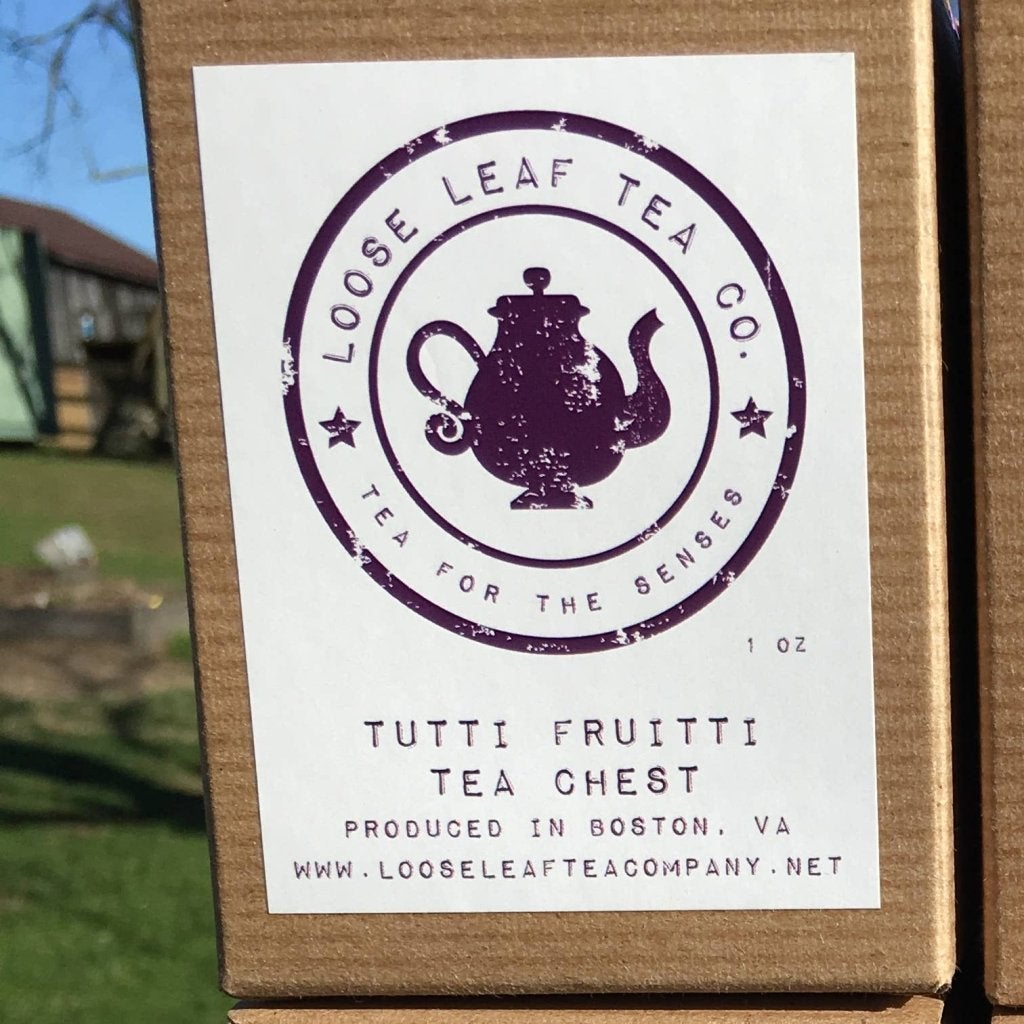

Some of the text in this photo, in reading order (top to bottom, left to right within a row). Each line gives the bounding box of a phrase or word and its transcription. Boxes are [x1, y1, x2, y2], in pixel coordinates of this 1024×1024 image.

[321, 156, 760, 364] LOOSE LEAF TEA CO.
[361, 483, 743, 615] TEA FOR THE SENSES
[746, 636, 806, 654] 1 OZ
[363, 716, 757, 749] TUTTI FRUITTI
[429, 765, 699, 798] TEA CHEST
[345, 818, 502, 839] PRODUCED
[530, 818, 564, 838] IN
[754, 815, 790, 835] VA
[293, 855, 842, 880] WWW.LOOSELEAFTEACOMPANY.NET
